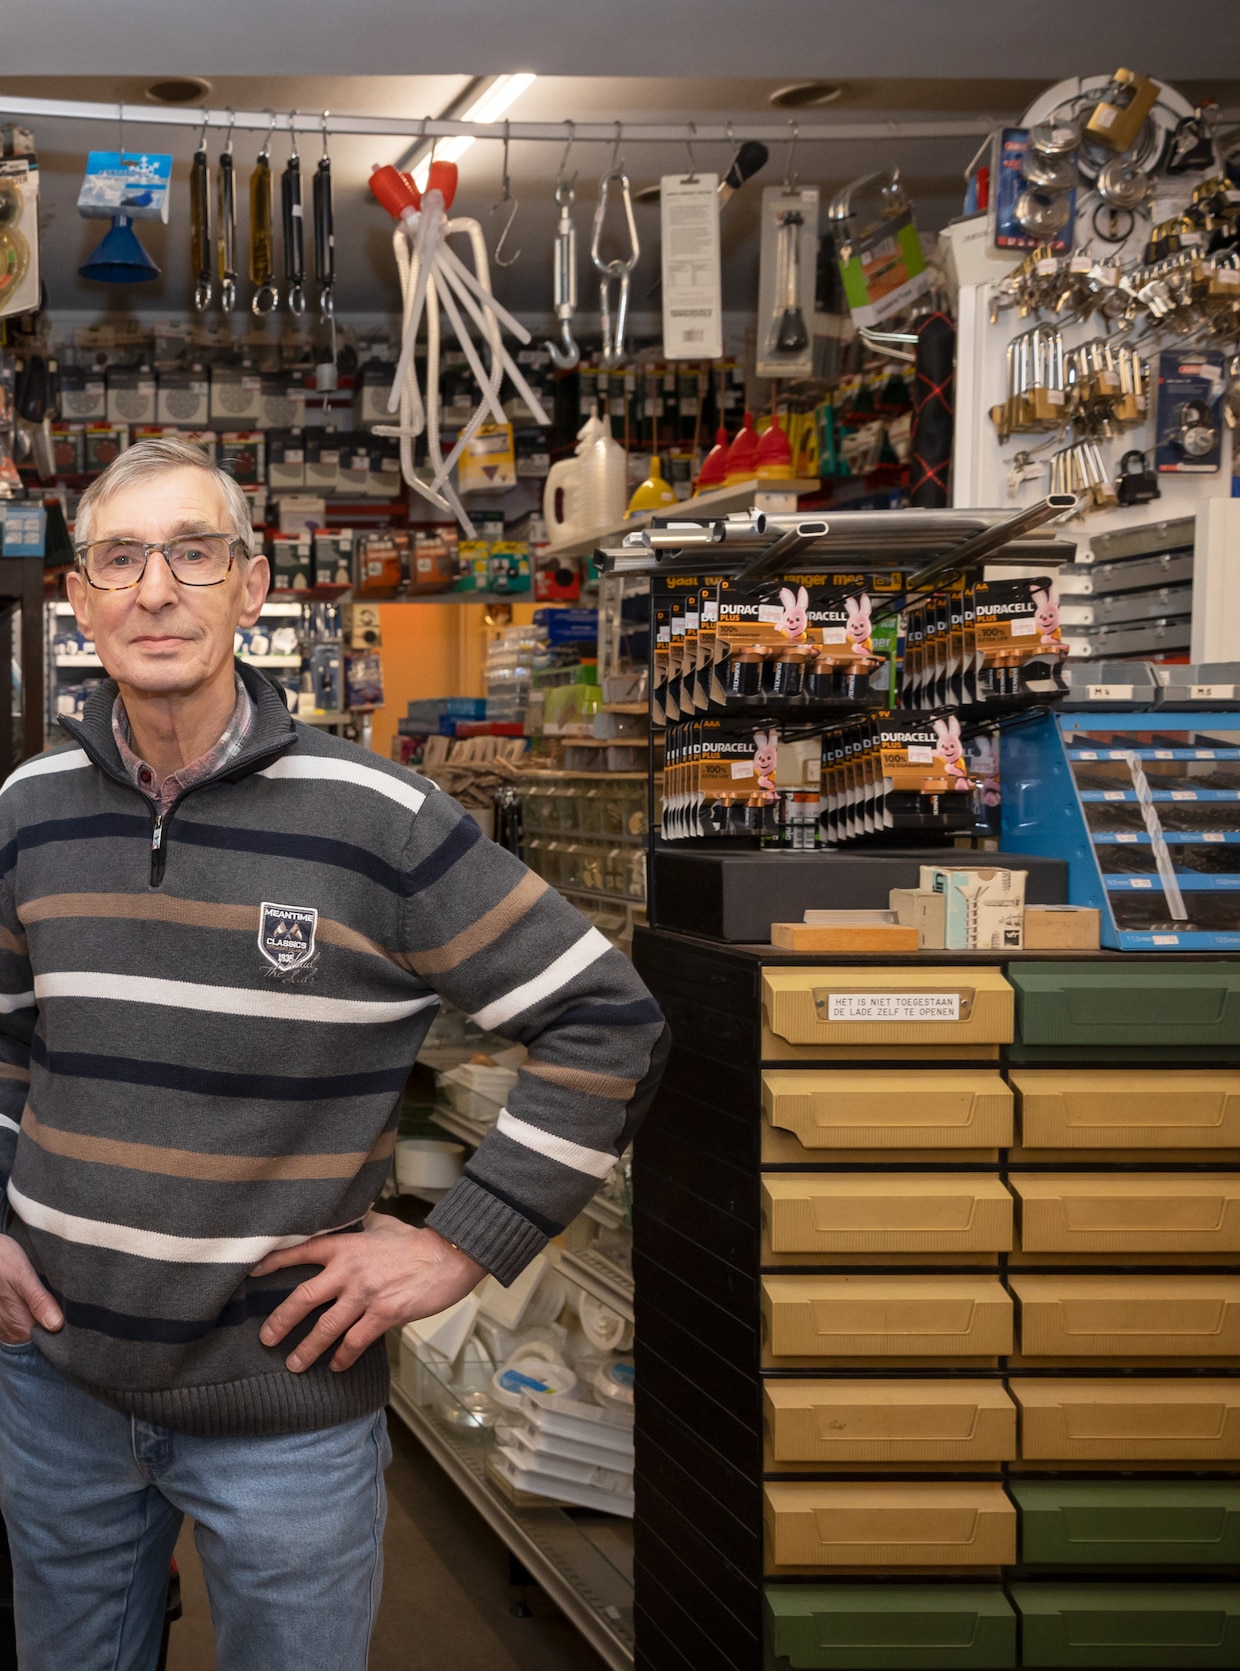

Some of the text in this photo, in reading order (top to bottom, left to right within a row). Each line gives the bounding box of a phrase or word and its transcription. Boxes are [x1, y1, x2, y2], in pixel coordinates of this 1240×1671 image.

[722, 581, 729, 589] D
[702, 589, 709, 597] D
[976, 602, 1035, 616] DURACELL
[720, 614, 741, 622] PLUS
[807, 611, 848, 621] RACELL
[872, 637, 890, 648] per
[879, 710, 891, 718] 9V
[880, 732, 937, 743] DURACELL
[702, 742, 755, 753] DURACELL
[883, 754, 907, 763] 100%
[264, 908, 314, 922] MEANTIME
[266, 937, 307, 949] CLASSICS
[835, 998, 953, 1006] HET IS NIET TOEGESTAAN
[833, 1008, 954, 1016] DE LADE ZELF TE OPENEN
